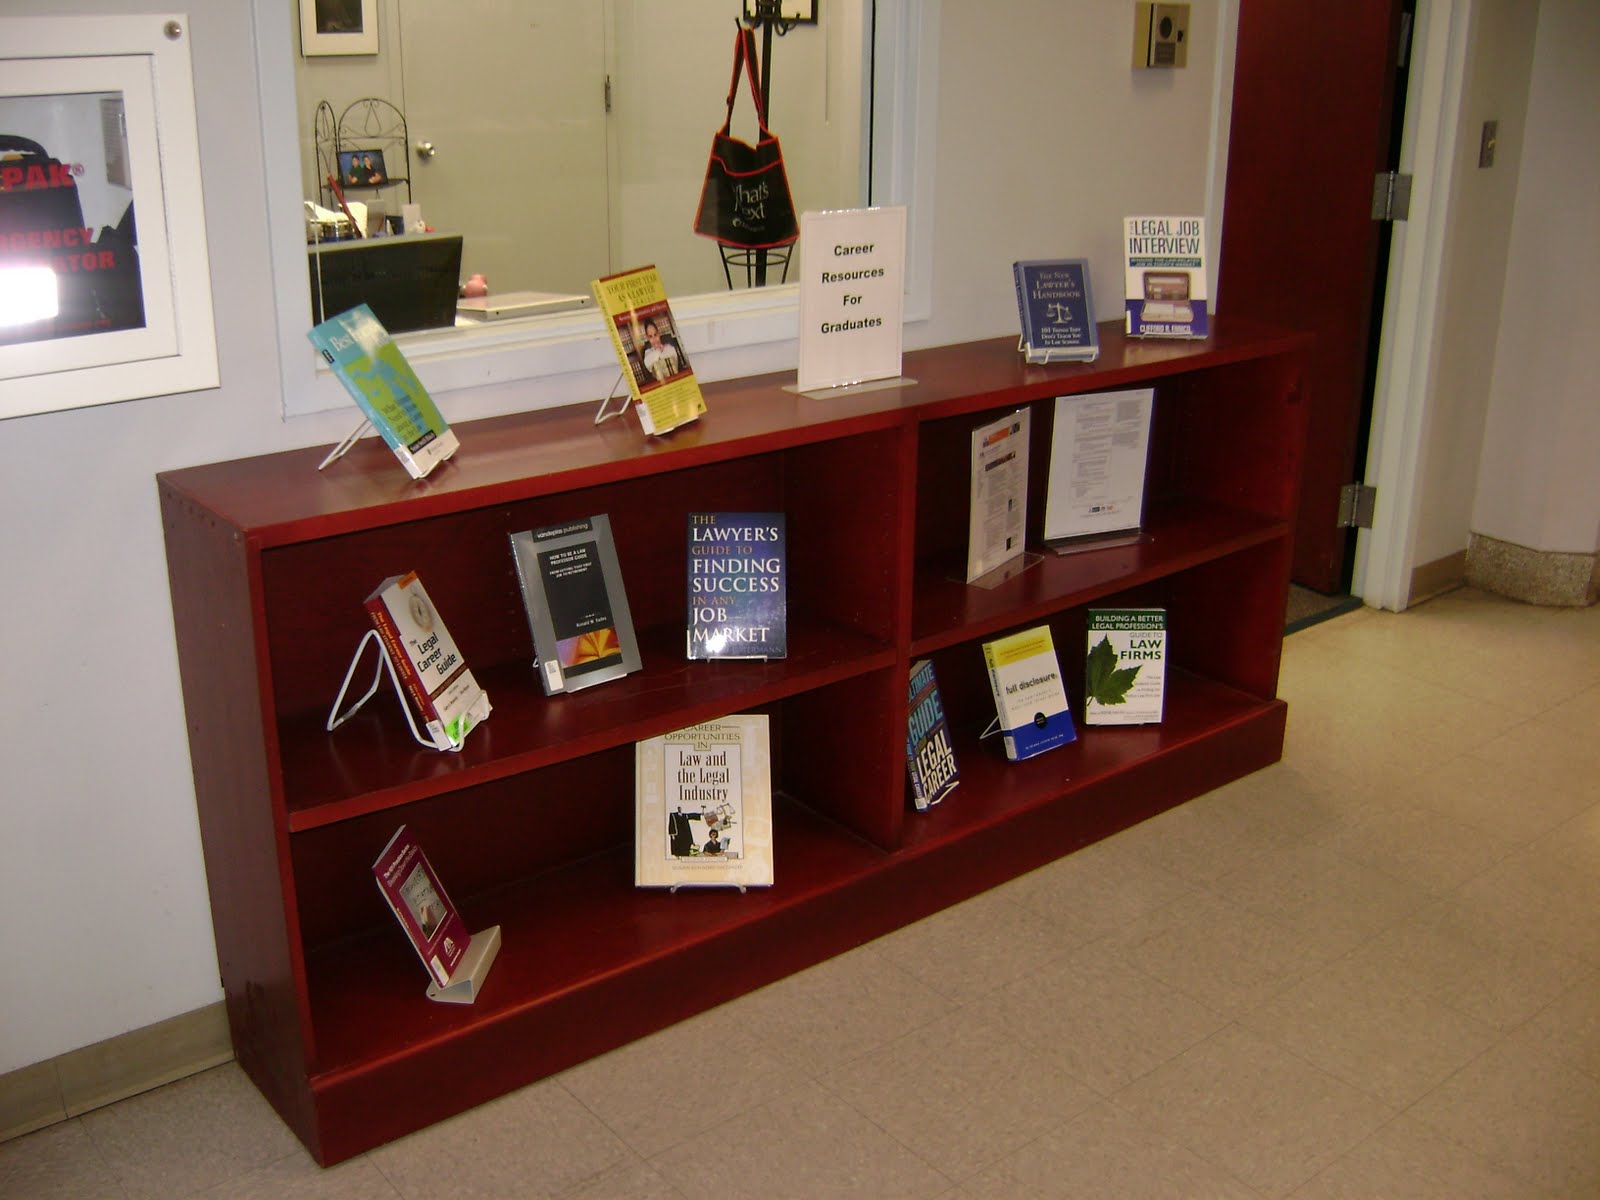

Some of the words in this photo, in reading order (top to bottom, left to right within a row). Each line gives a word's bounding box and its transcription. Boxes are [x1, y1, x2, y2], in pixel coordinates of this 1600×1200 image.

[1135, 221, 1172, 235] LEGAL
[1177, 221, 1199, 236] JOB
[834, 244, 874, 256] Career
[1129, 238, 1200, 254] INTERVIEW
[822, 267, 884, 283] Resources
[843, 295, 862, 306] For
[821, 317, 882, 334] Graduates
[692, 515, 716, 524] THE
[563, 523, 588, 534] publishing
[693, 527, 778, 541] LAWYER'S
[692, 546, 731, 555] GUIDE
[736, 546, 752, 554] TO
[693, 559, 780, 574] FINDING
[693, 577, 779, 592] SUCCESS
[692, 596, 706, 605] IN
[711, 596, 736, 605] ANY
[693, 607, 727, 625] JOB
[693, 628, 770, 642] MARKET
[418, 632, 439, 654] Legal
[1130, 640, 1162, 648] LAW
[417, 647, 442, 672] Career
[1121, 651, 1162, 660] FIRMS
[436, 653, 457, 675] Guide
[1005, 684, 1018, 695] full
[909, 690, 943, 748] GUIDE
[664, 733, 740, 741] OPPORTUNITIES
[679, 751, 701, 766] Law
[705, 751, 727, 766] and
[916, 729, 952, 784] LEGAL
[678, 768, 695, 784] the
[700, 768, 730, 786] Legal
[922, 753, 957, 804] CAREER
[679, 785, 729, 802] Industry
